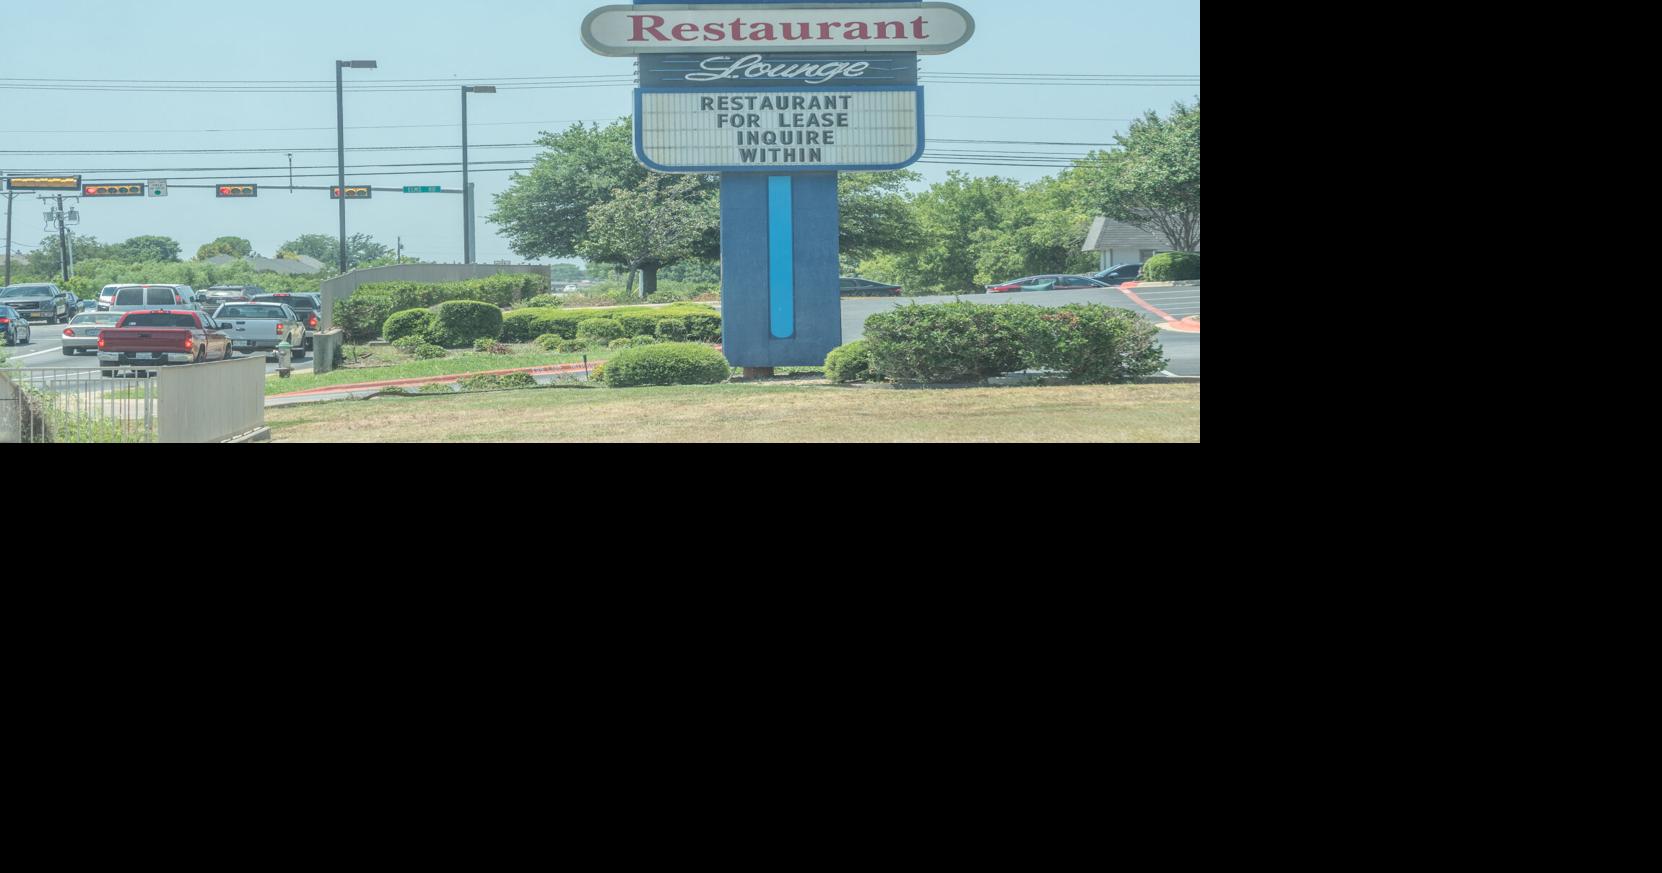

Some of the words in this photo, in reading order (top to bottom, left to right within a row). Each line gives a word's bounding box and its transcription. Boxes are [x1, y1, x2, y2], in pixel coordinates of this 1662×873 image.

[627, 15, 929, 42] Restaurant
[685, 54, 869, 84] Lounge
[701, 96, 852, 111] RESTAURANT
[717, 114, 760, 128] FOR
[779, 113, 848, 128] LEASE
[737, 130, 834, 145] INQUIRE
[740, 147, 822, 163] WITHIN
